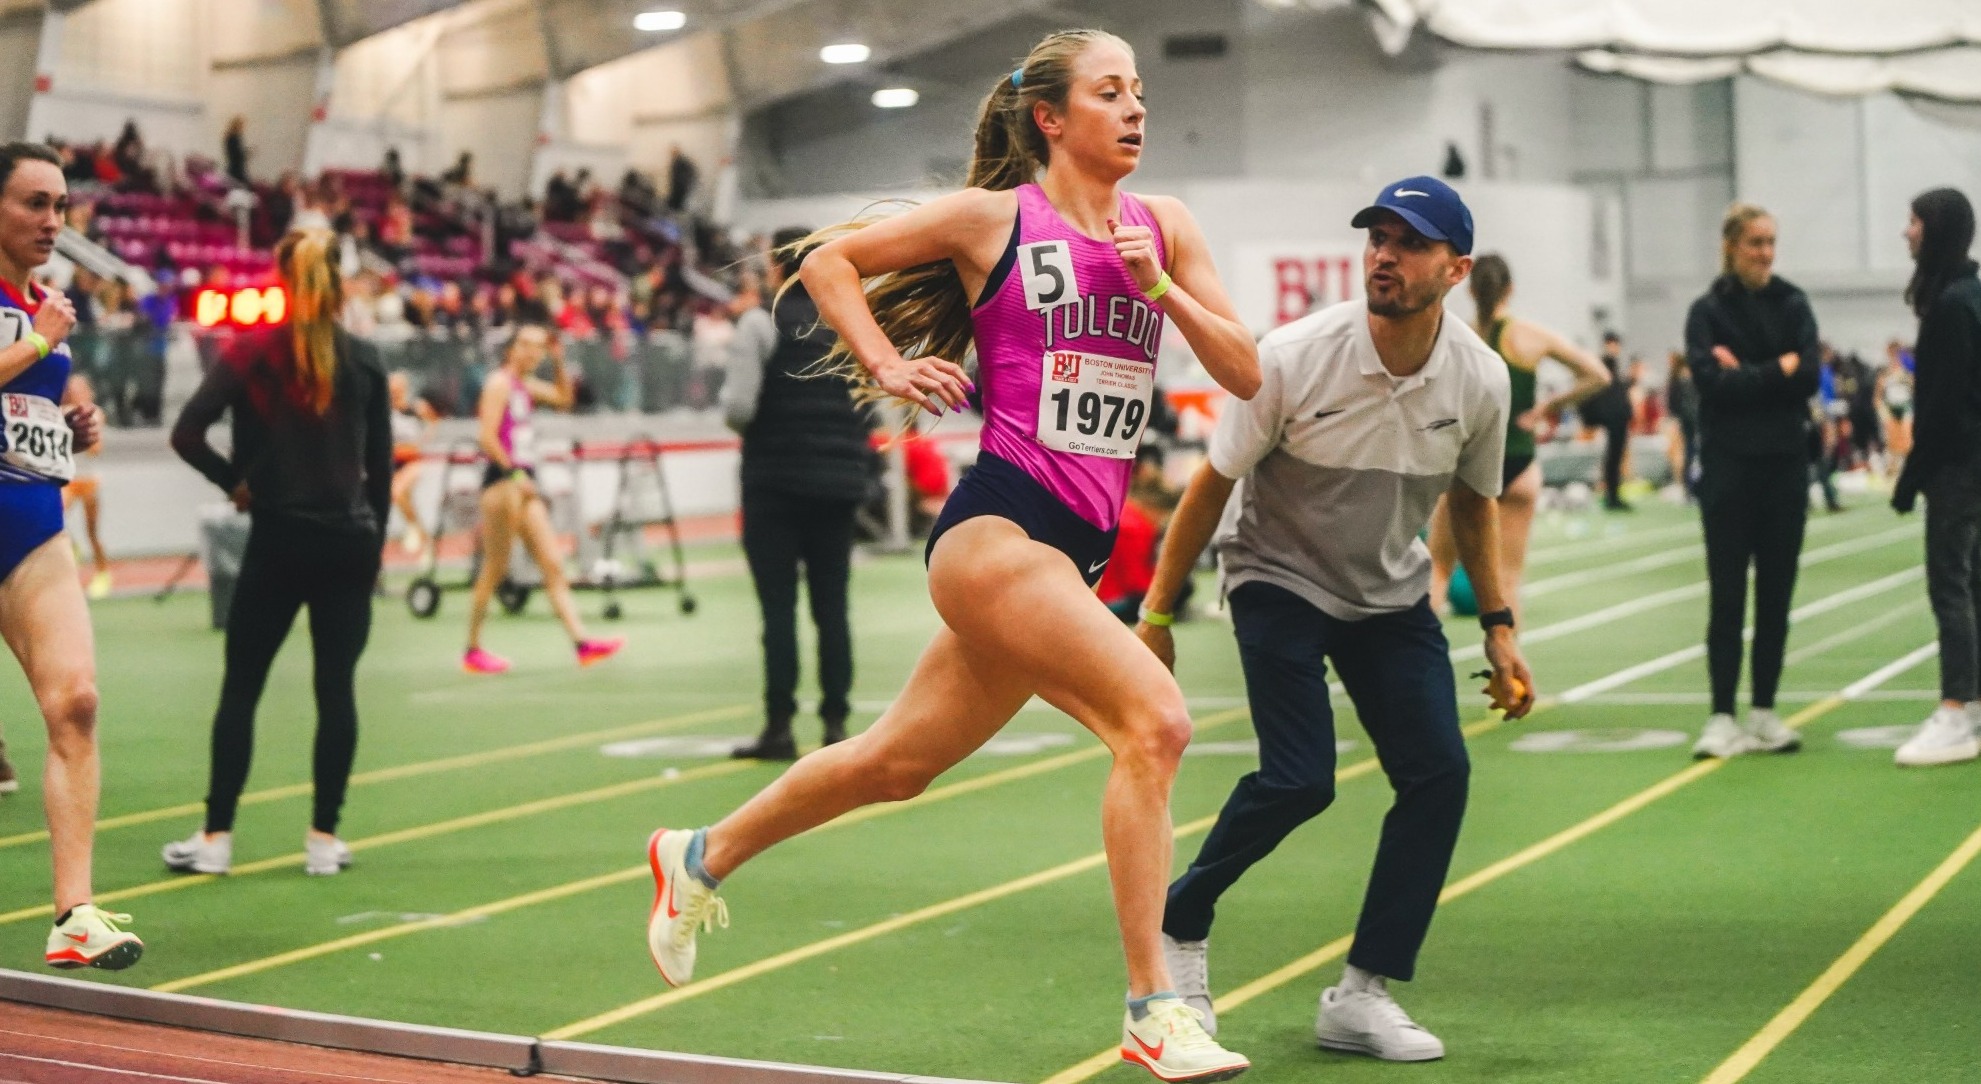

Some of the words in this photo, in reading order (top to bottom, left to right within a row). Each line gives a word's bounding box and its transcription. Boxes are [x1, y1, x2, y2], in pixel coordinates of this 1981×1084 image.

[1030, 244, 1065, 304] 5
[1273, 258, 1352, 322] BU
[3, 311, 23, 342] 7
[1039, 293, 1160, 360] TOLEDO
[1052, 353, 1082, 377] BU
[1084, 358, 1114, 369] BOSTON
[1114, 372, 1136, 381] THOMAS
[1051, 388, 1145, 441] 1979
[12, 422, 69, 463] 2014
[1068, 441, 1118, 455] GoTerriers.com
